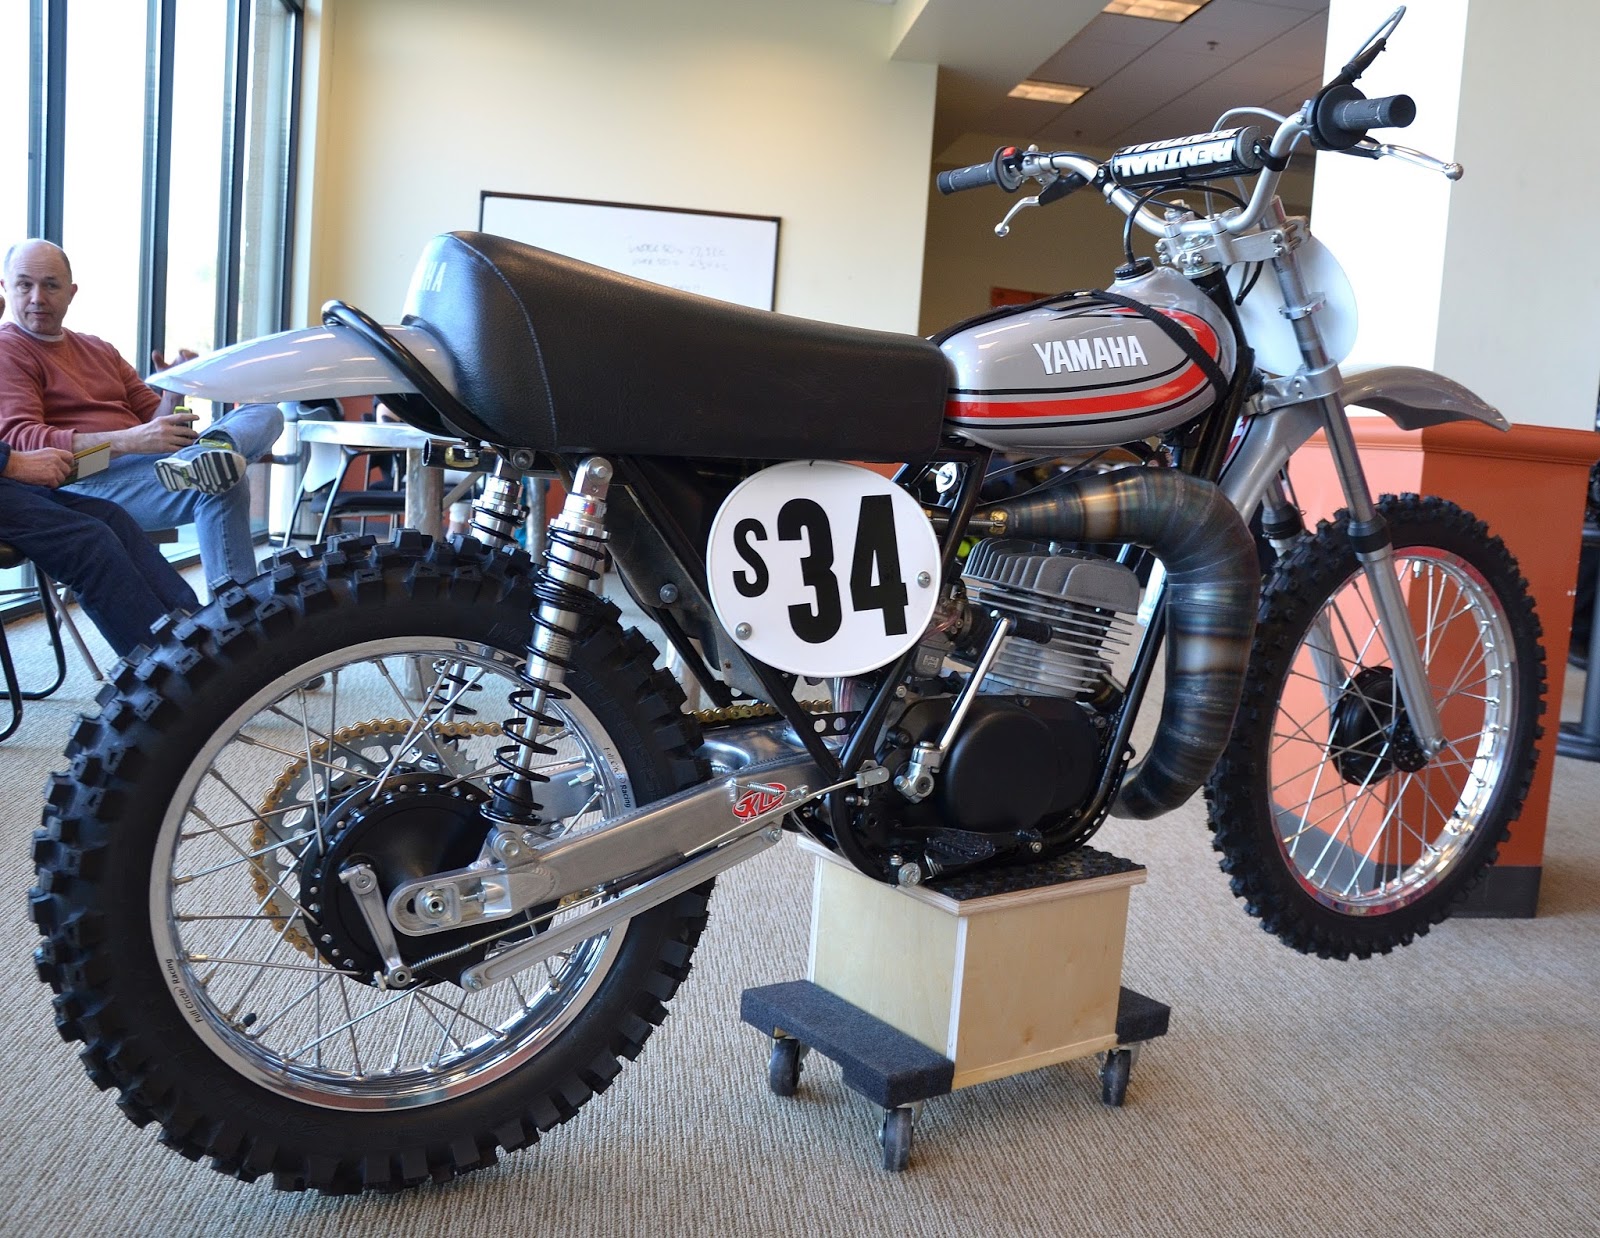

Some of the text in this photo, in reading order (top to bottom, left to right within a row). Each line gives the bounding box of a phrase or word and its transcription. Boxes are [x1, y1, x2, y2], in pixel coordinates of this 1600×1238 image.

[1114, 138, 1236, 178] RENTHAL
[1032, 335, 1149, 375] YAMAHA
[620, 784, 632, 808] Racing
[166, 958, 203, 1023] Full Circle Racing
